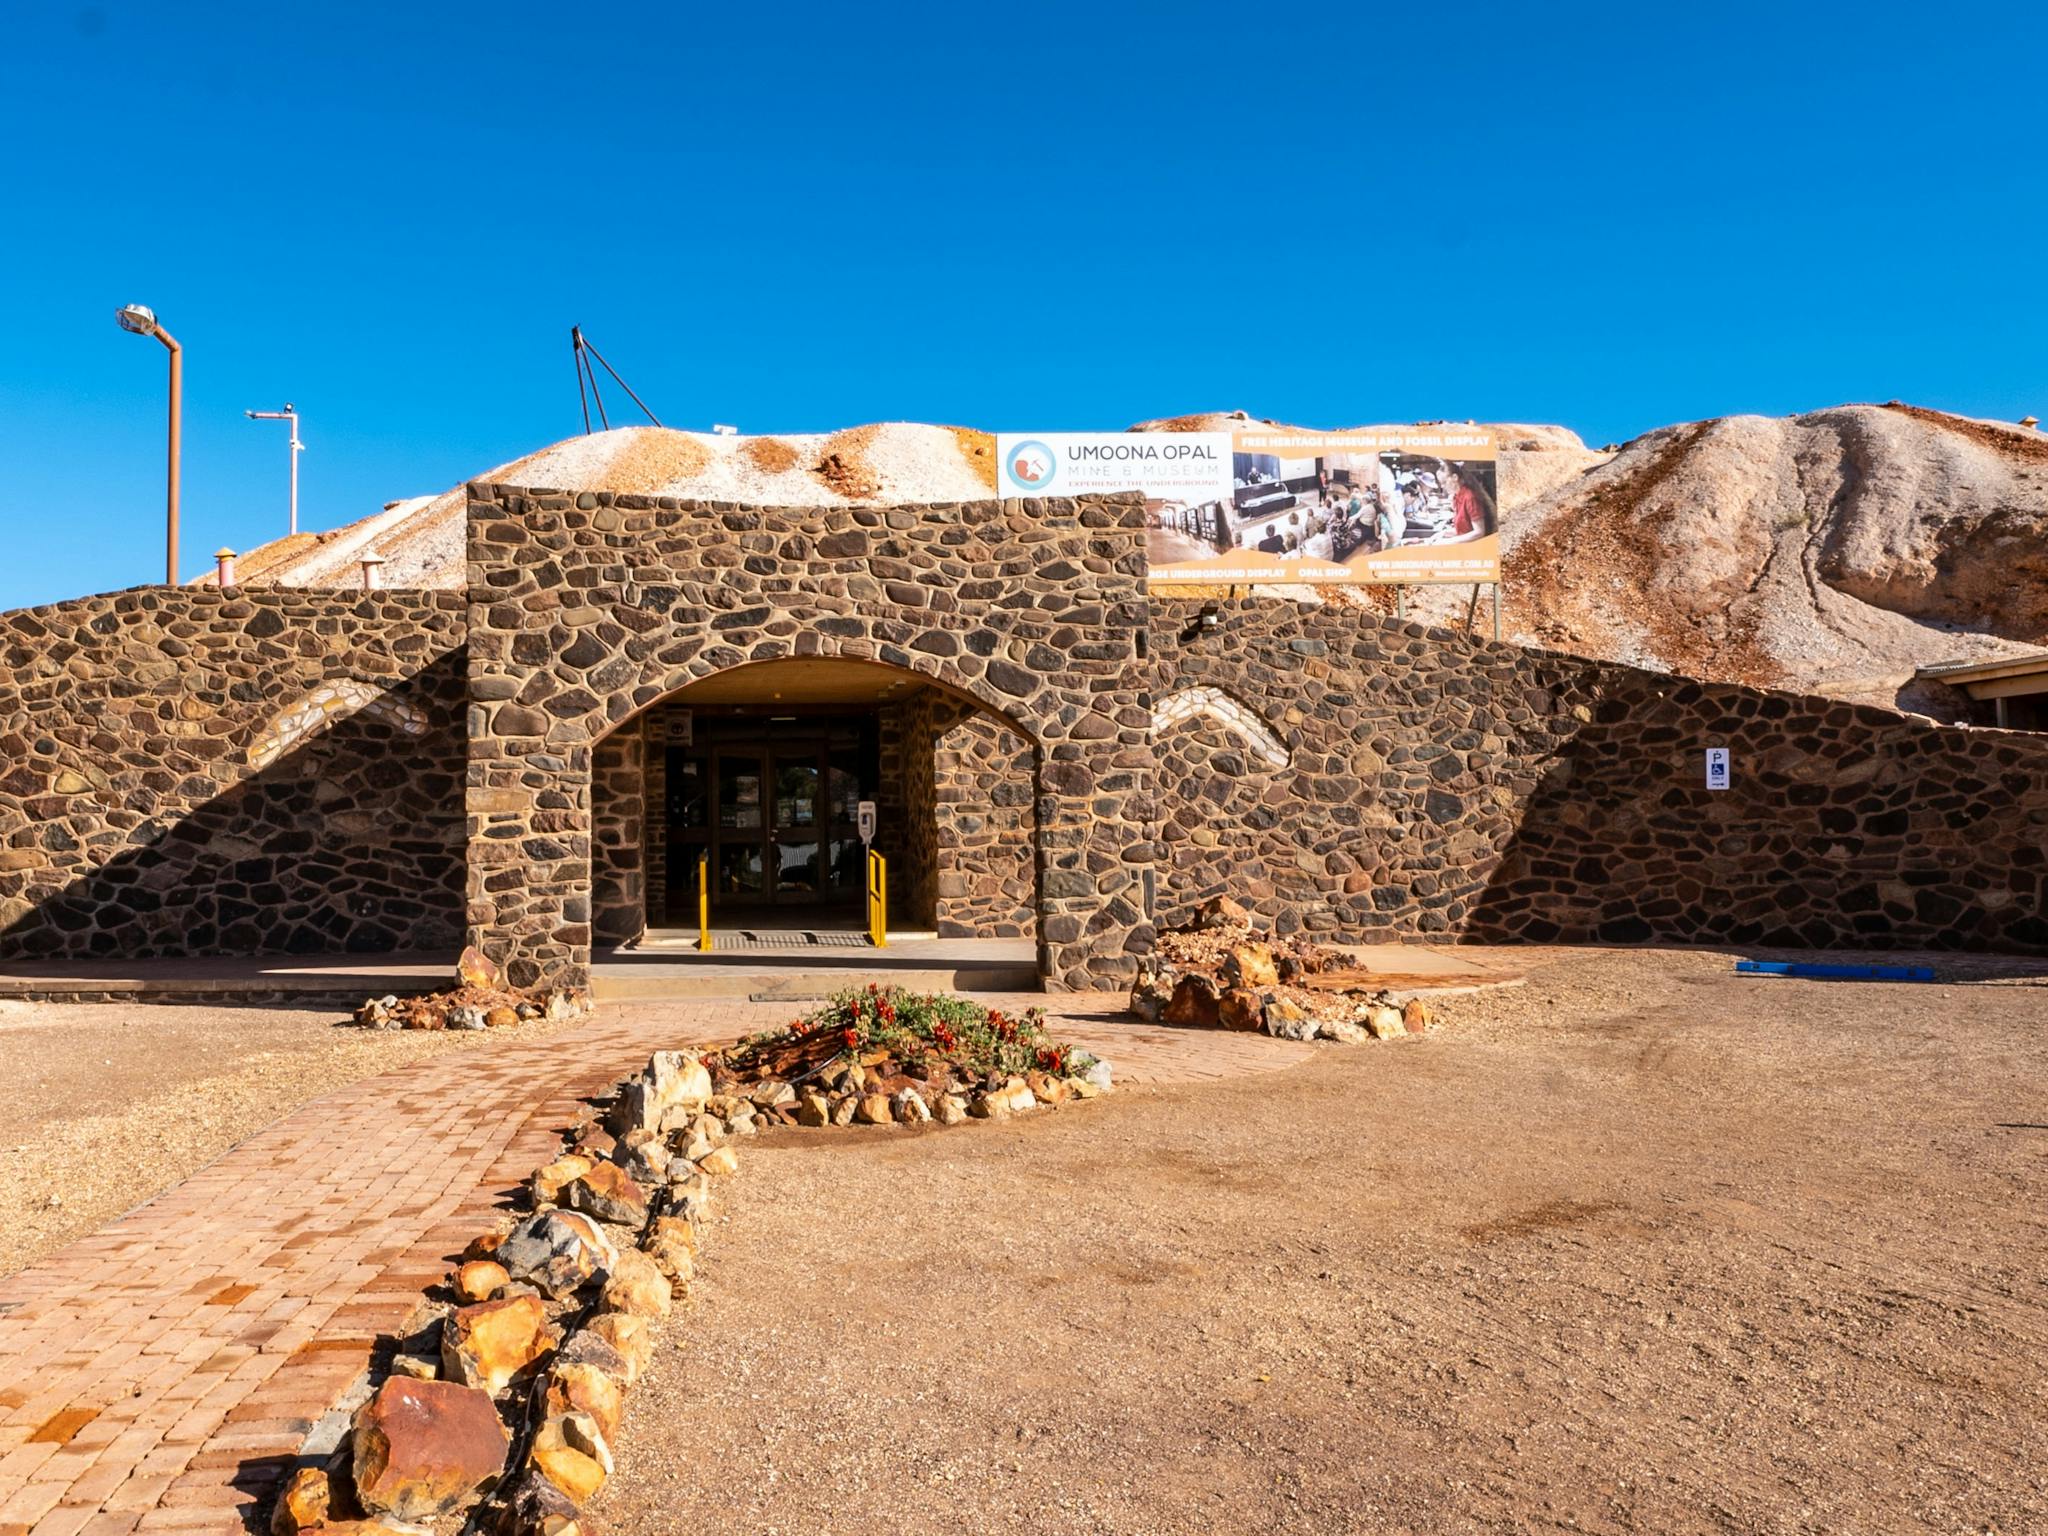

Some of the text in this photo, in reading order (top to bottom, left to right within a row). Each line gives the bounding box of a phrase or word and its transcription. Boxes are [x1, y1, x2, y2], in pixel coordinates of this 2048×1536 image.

[1241, 437, 1267, 447] FREE
[1269, 437, 1323, 447] HERITAGE
[1325, 437, 1377, 447] MUSEUM
[1379, 436, 1403, 446] AND
[1444, 436, 1490, 446] DISPLAY
[1068, 445, 1218, 460] UMOONA OPAL
[1068, 465, 1111, 476] MINE
[1143, 465, 1219, 476] MUSEUM
[1170, 569, 1245, 579] UNDERGROUND
[1247, 569, 1287, 578] DISPLAY
[1298, 568, 1324, 577] OPAL
[1325, 568, 1352, 577] SHOP
